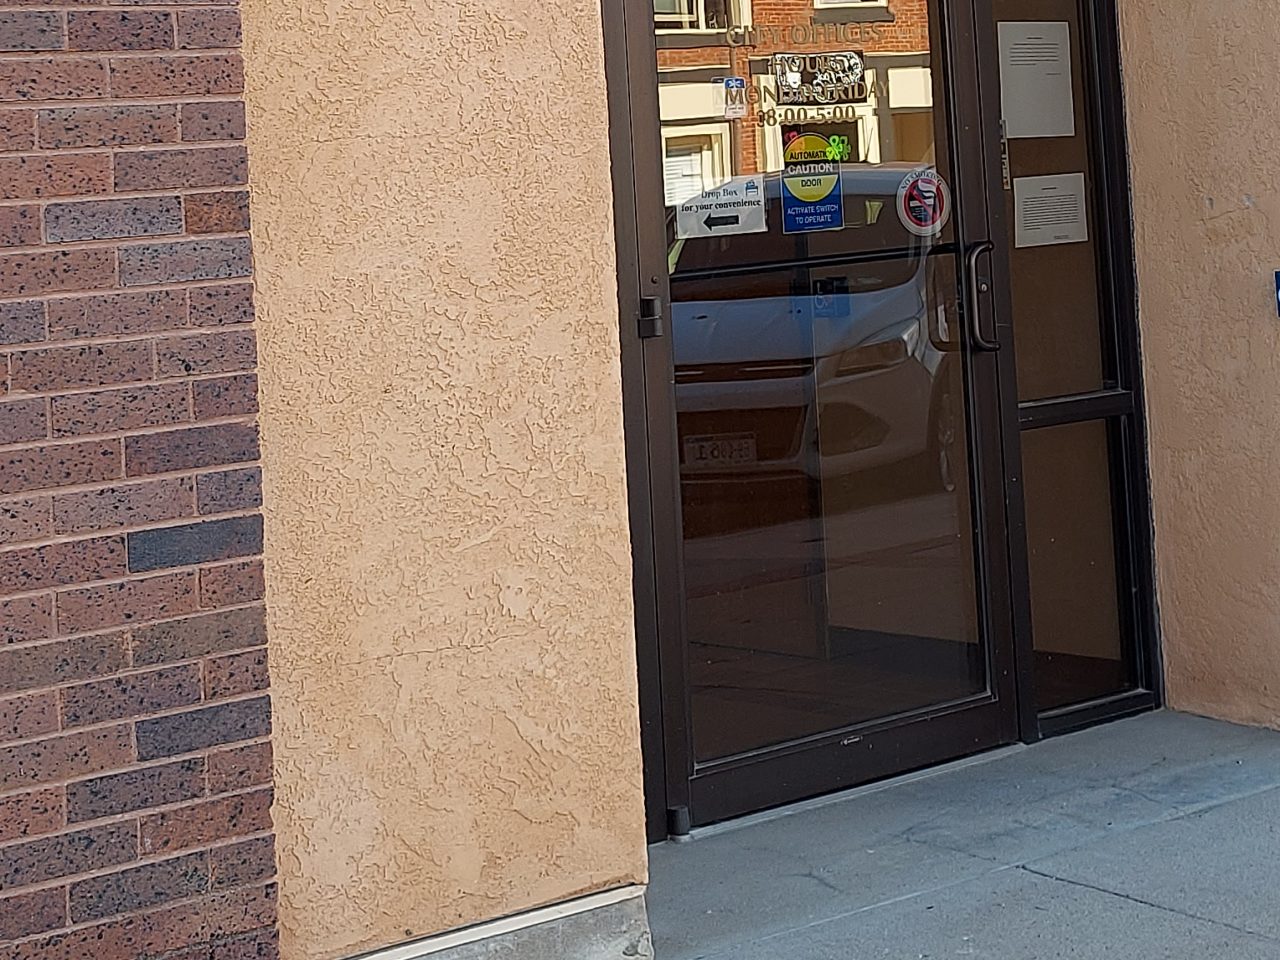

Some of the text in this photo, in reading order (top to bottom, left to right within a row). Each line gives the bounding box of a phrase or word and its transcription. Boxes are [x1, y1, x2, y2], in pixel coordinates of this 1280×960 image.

[726, 21, 885, 47] CITY OFFICES
[787, 162, 833, 175] CAUTION
[801, 178, 822, 188] DOOR
[701, 188, 739, 200] Drop Box
[681, 198, 762, 213] for your convenience
[787, 204, 839, 215] ACTIVATE SWITCH
[795, 214, 832, 224] TO OPERATE
